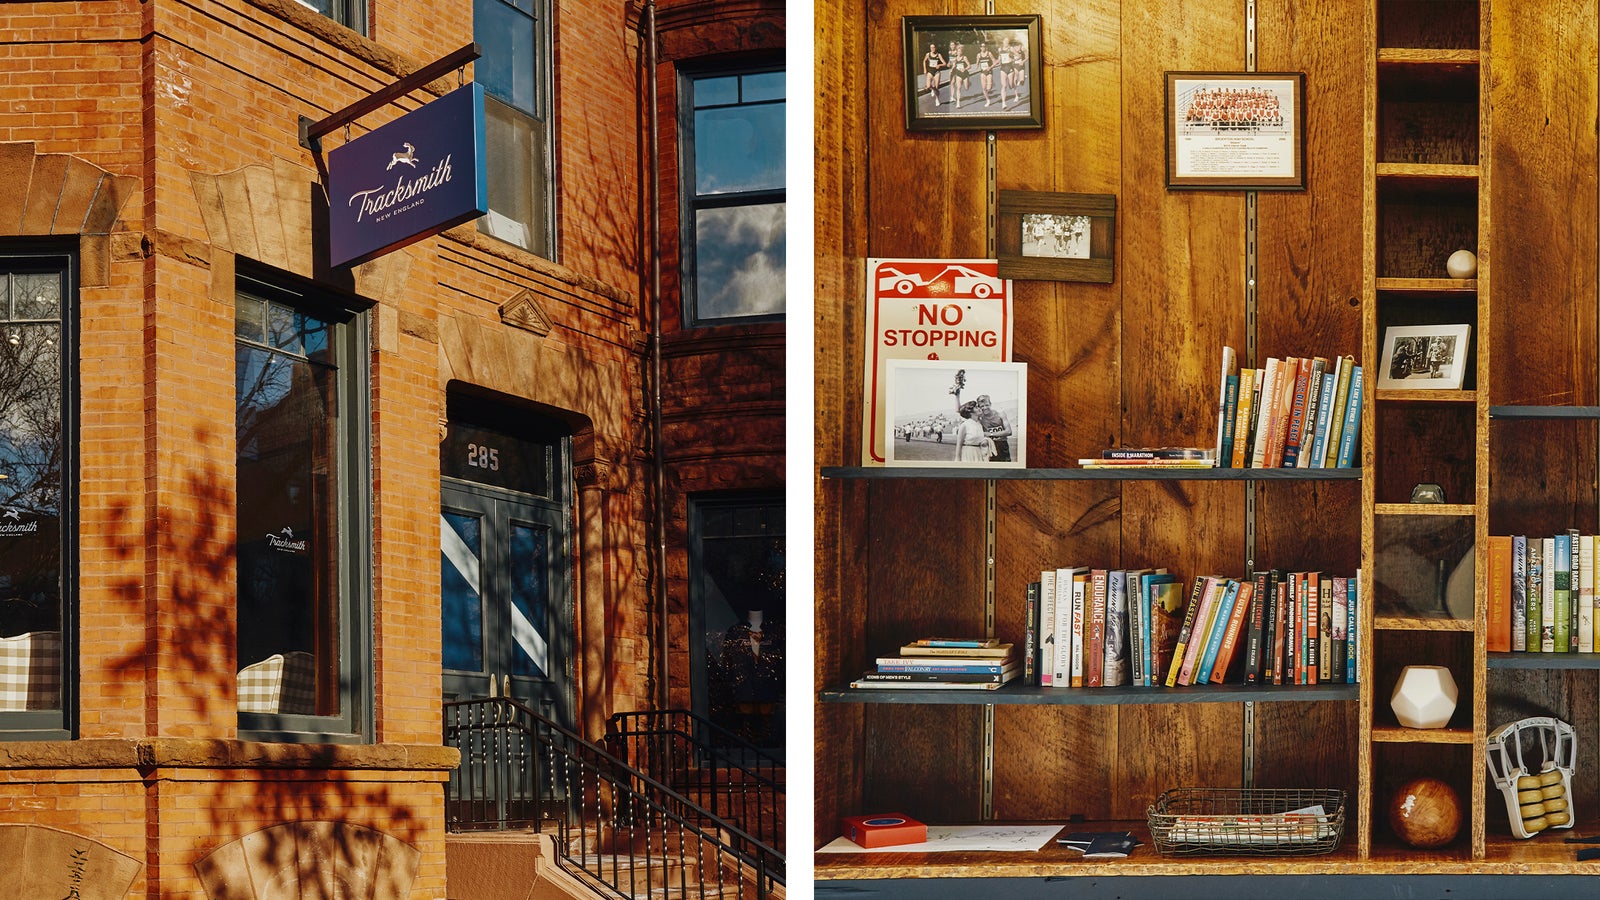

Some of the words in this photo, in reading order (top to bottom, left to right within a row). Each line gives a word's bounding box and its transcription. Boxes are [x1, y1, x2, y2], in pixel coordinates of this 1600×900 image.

[349, 154, 452, 222] Tracksmith
[376, 213, 391, 222] NEW
[393, 198, 425, 216] ENGLAND
[918, 304, 963, 326] NO
[883, 329, 997, 347] STOPPING
[1311, 370, 1321, 401] SOMETHING
[1353, 375, 1361, 388] RACE
[1294, 394, 1304, 406] DIE
[1240, 407, 1248, 438] BARBARIAN
[1289, 419, 1300, 442] PEACE
[468, 443, 499, 471] 285
[0, 520, 38, 532] cksmith
[266, 533, 305, 550] Tracksmith
[1110, 576, 1118, 612] RUNNING
[1192, 581, 1202, 597] RUN
[1257, 575, 1265, 591] CHECK
[1322, 588, 1331, 598] H
[1093, 575, 1104, 623] ENDURANCE
[1233, 598, 1245, 618] ULTRA
[1308, 586, 1317, 626] MARATHON
[1184, 597, 1197, 627] FASTER
[1254, 604, 1262, 631] TECHNIQUE
[1223, 619, 1238, 649] RUNNERS
[1348, 633, 1354, 641] ME
